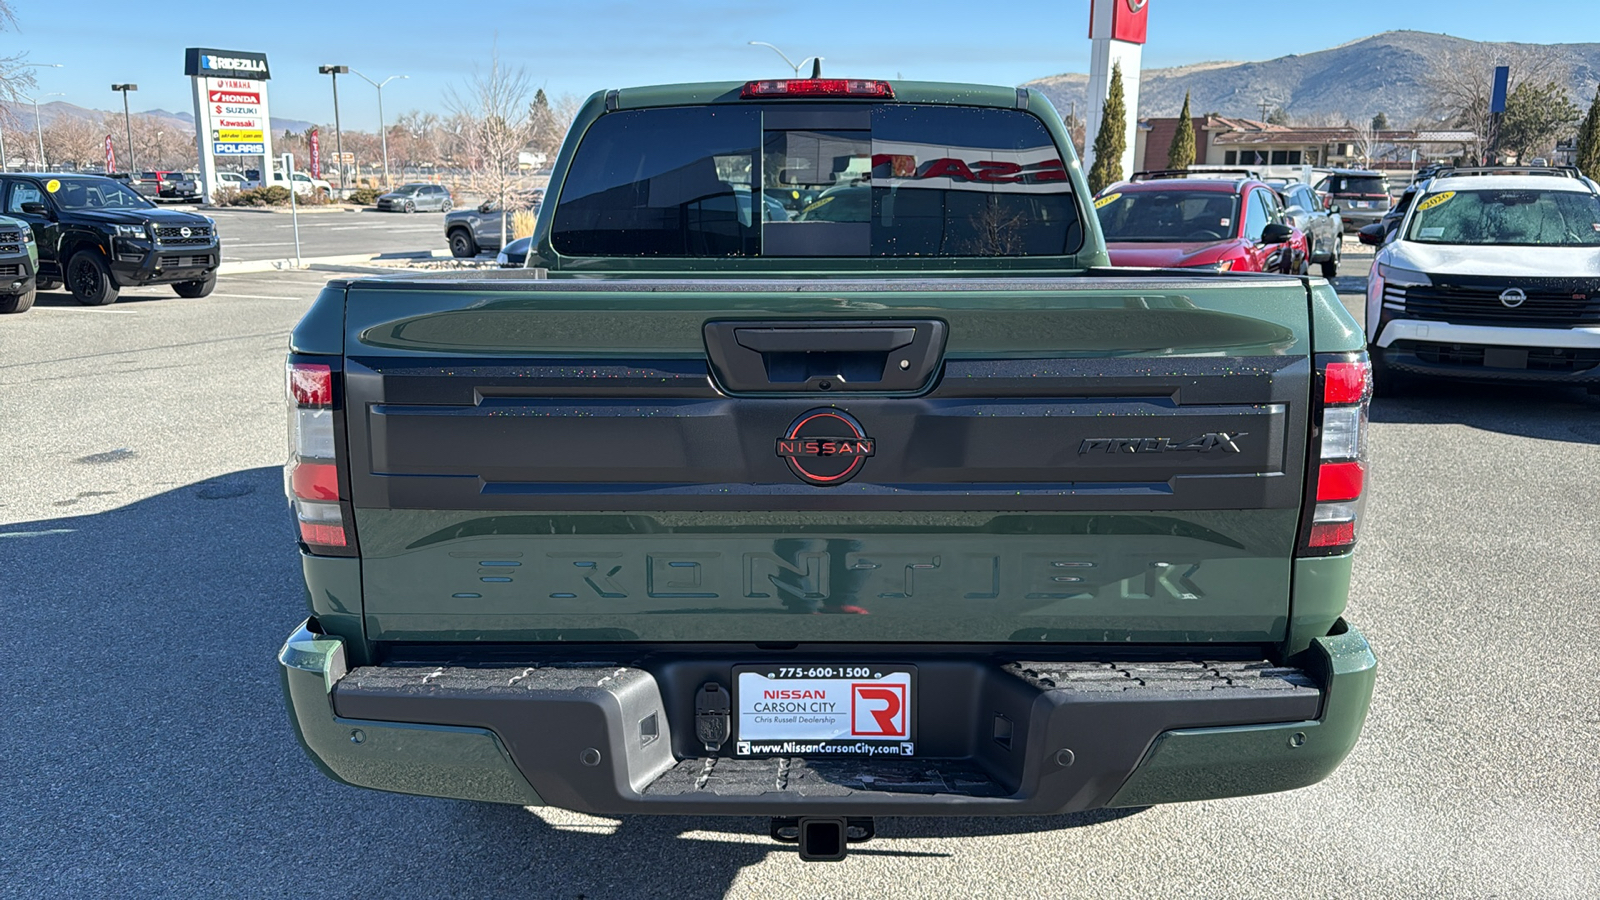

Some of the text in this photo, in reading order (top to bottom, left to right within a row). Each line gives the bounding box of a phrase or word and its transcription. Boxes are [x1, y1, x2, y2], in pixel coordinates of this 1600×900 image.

[217, 57, 267, 72] RIDEZILLA
[225, 80, 251, 89] YAMAHA
[221, 94, 258, 103] HONDA
[220, 119, 255, 127] Kawasaki
[216, 144, 264, 153] POLARIS
[1424, 193, 1449, 208] 2026
[780, 442, 872, 454] NISSAN
[1078, 432, 1249, 454] PRO-4X
[448, 551, 1207, 601] FRONTIER
[779, 668, 870, 678] 775-600-1500
[764, 690, 826, 699] NISSAN
[754, 702, 836, 713] CARSON CITY
[754, 716, 836, 725] Chris Russell Dealership
[752, 742, 899, 756] www.NissanCarsonCity.com
